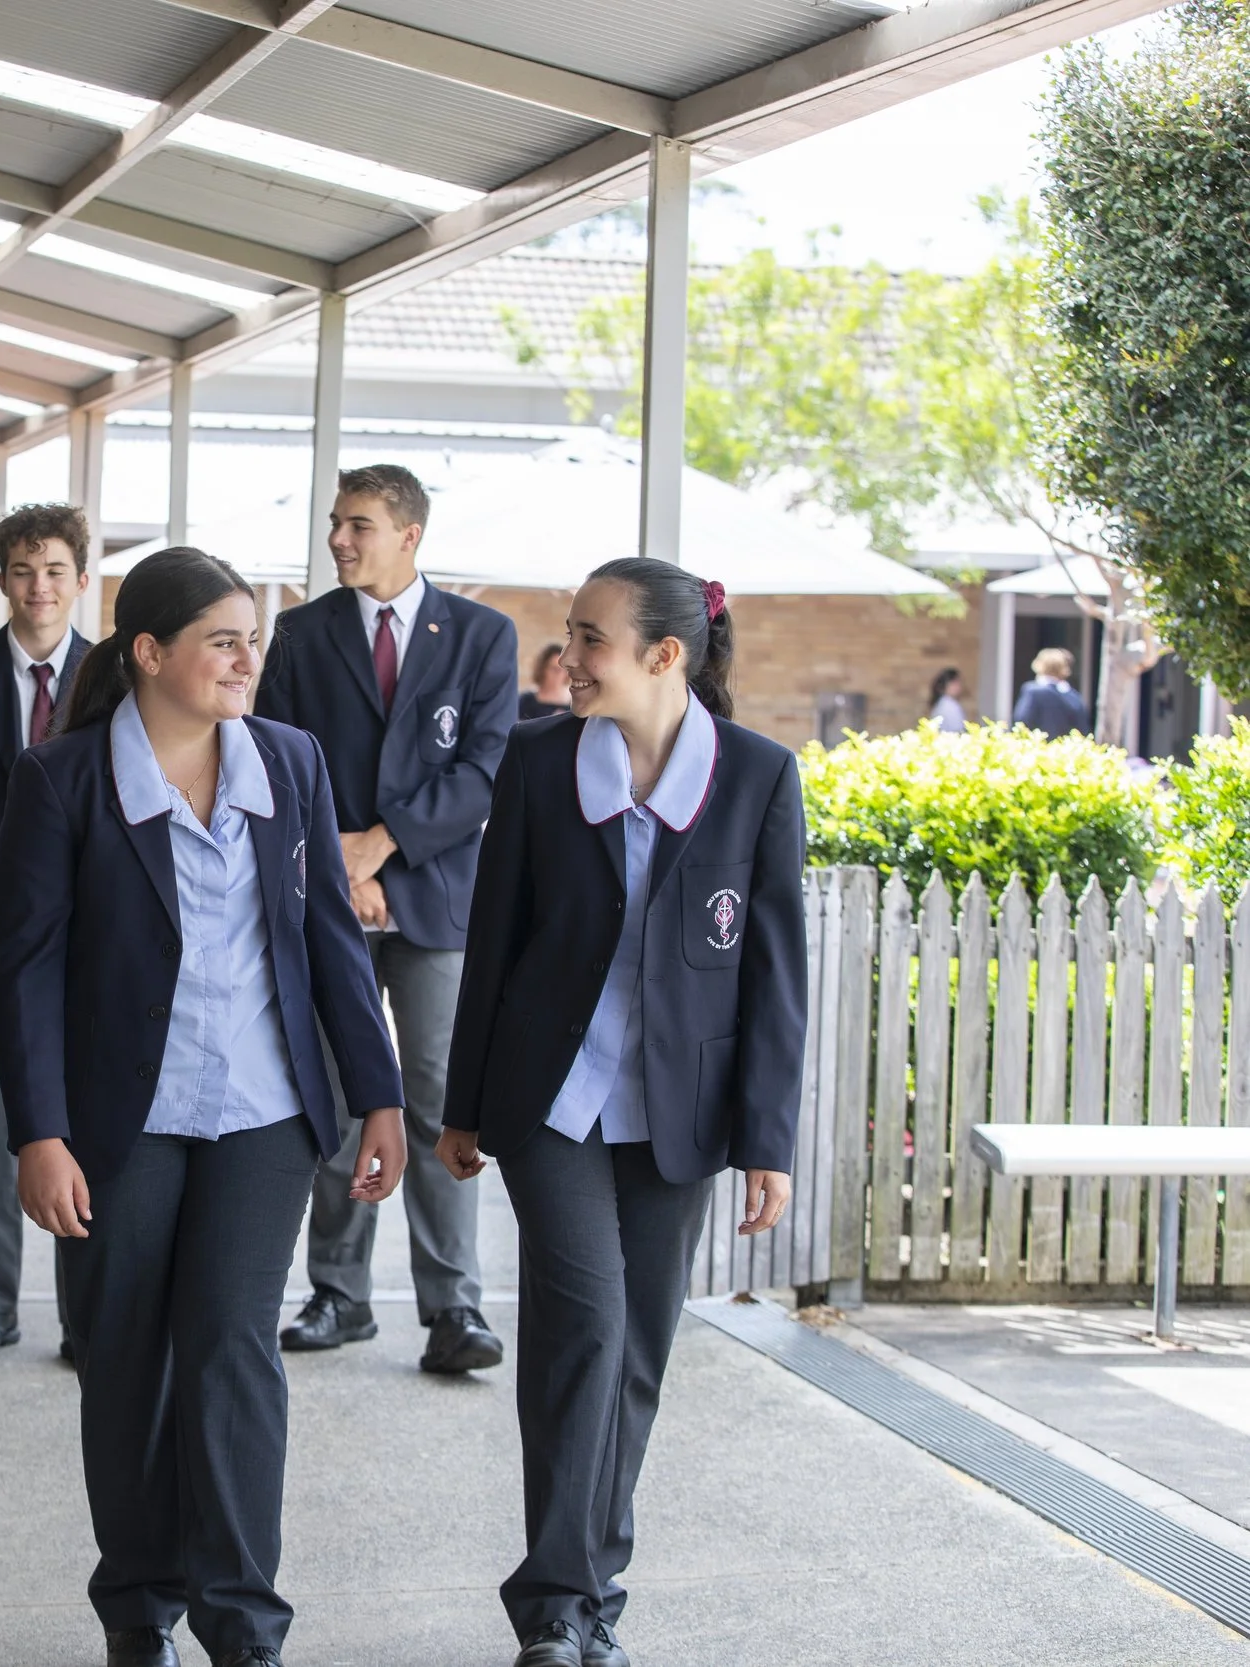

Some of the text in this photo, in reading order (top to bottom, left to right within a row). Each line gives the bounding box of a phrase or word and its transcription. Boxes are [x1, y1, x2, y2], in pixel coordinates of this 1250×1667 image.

[706, 888, 741, 908] HOLY SPIRIT COLLEGE
[707, 936, 716, 946] LIVE
[730, 933, 739, 946] TRUTH
